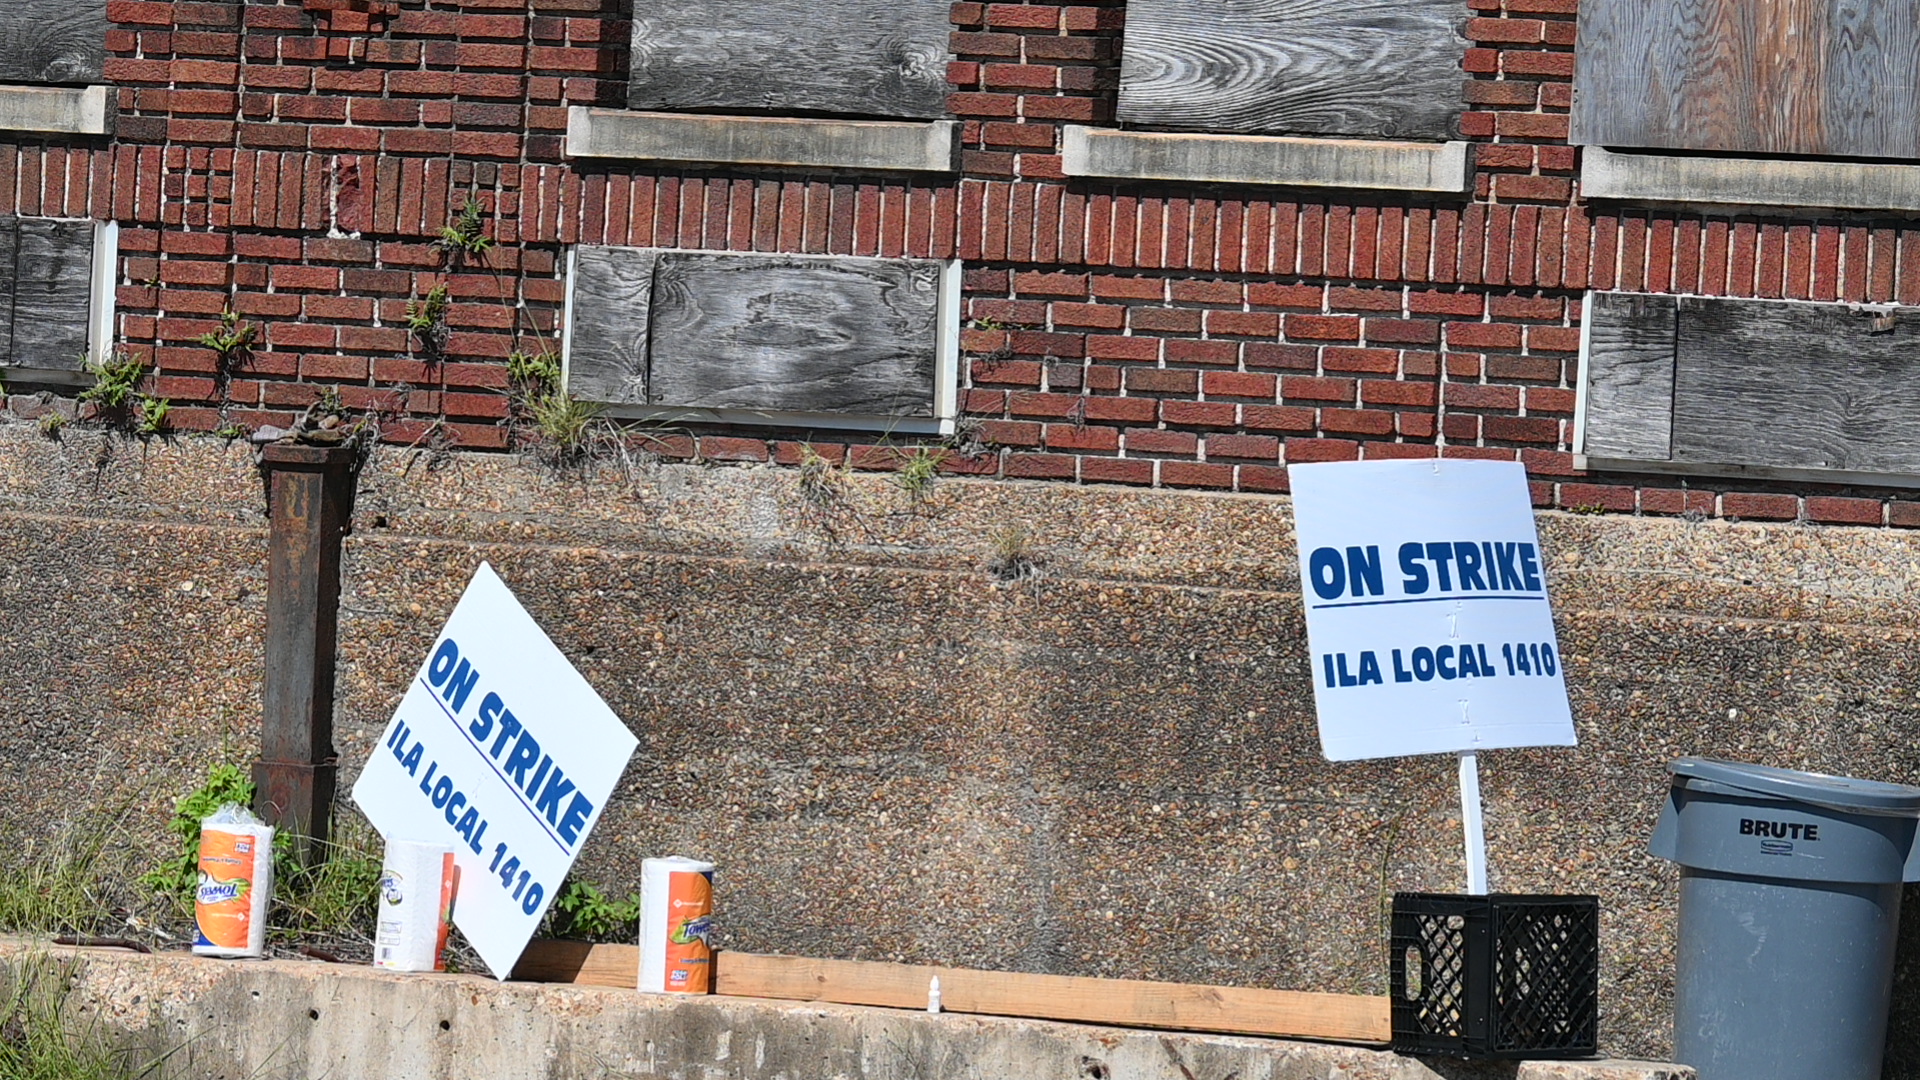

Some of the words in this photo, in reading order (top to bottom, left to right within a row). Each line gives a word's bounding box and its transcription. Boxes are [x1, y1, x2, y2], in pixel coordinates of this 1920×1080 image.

[1309, 545, 1385, 600] ON
[1398, 541, 1542, 594] STRIKE
[1323, 651, 1383, 688] ILA
[1392, 643, 1496, 683] LOCAL
[1502, 642, 1556, 677] 1410
[428, 638, 480, 714] ON
[469, 692, 594, 847] STRIKE
[387, 719, 424, 777] ILA
[420, 761, 488, 855] LOCAL
[490, 842, 544, 916] 1410
[1739, 818, 1818, 841] BRUTE
